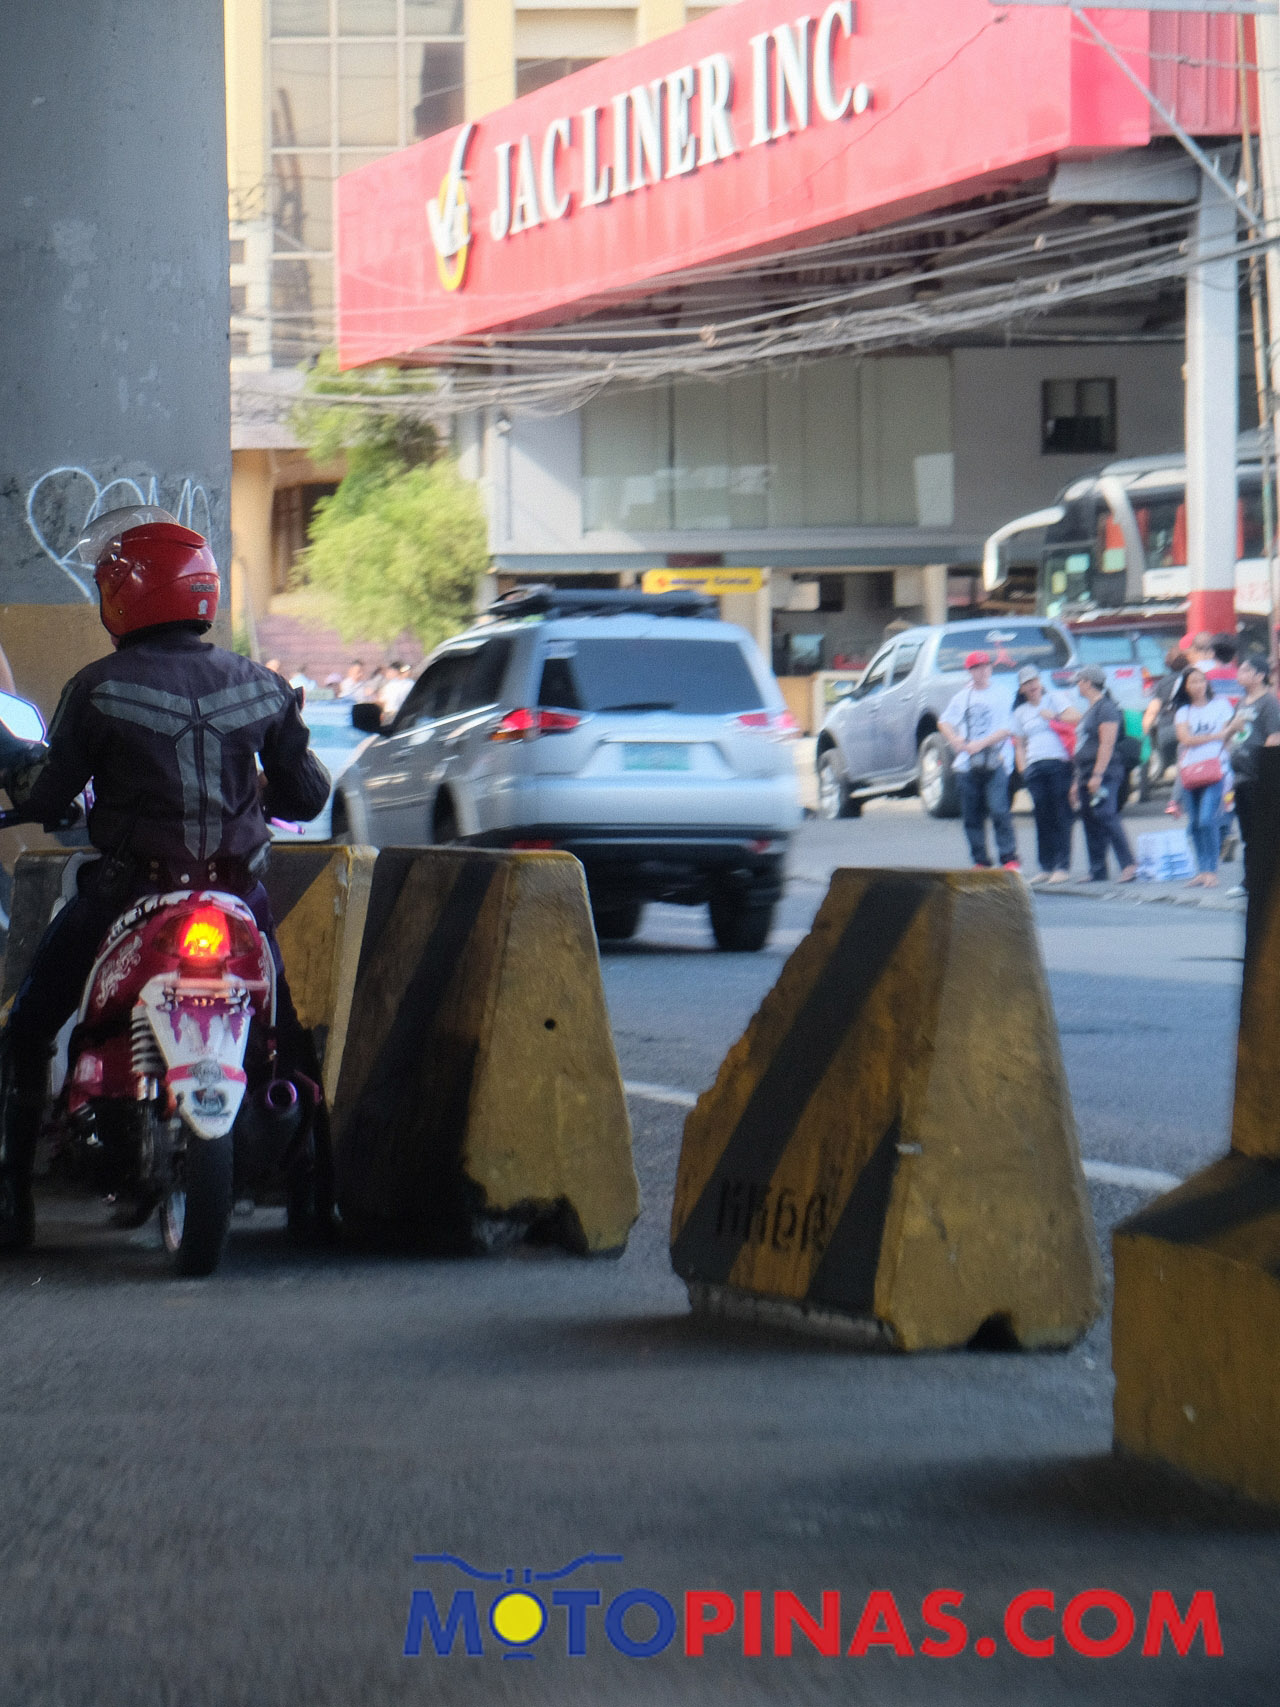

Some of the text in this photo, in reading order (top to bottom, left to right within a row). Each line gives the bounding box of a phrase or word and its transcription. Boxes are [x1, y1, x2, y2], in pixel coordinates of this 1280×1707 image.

[489, 0, 872, 241] JAC LINER INC.
